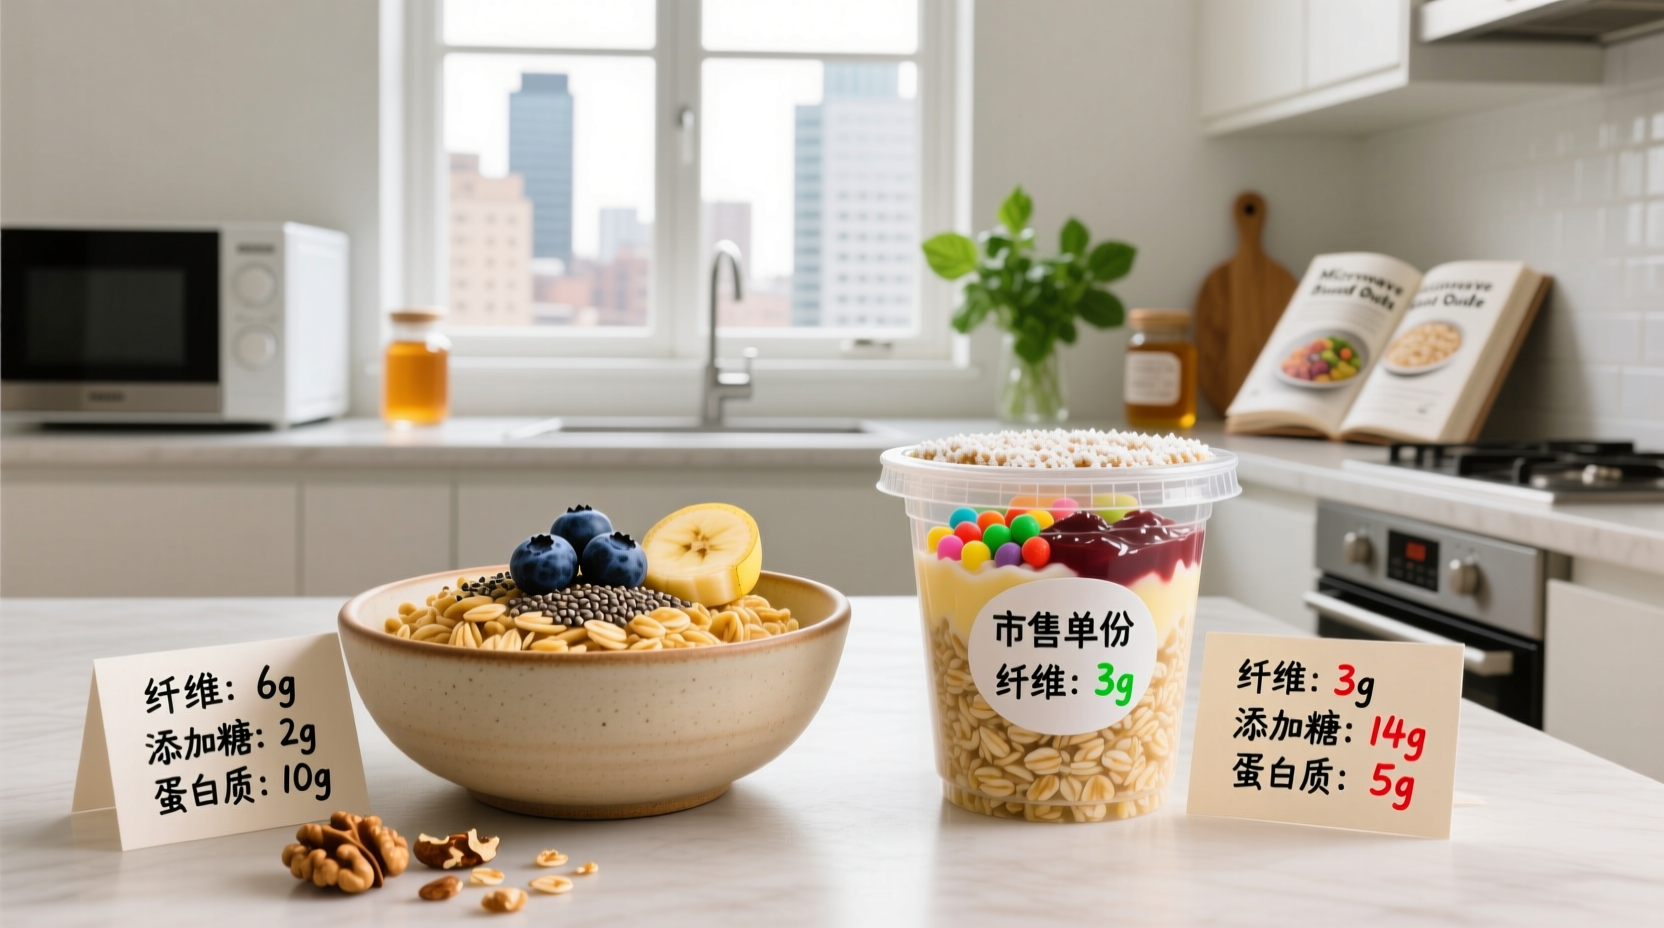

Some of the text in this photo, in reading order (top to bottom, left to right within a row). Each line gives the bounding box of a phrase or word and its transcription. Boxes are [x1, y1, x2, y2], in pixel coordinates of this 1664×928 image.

[993, 610, 1135, 649] 市售单份
[145, 664, 296, 714] 纤维： 6g
[996, 662, 1135, 706] 纤维： 3g
[1236, 659, 1375, 708] 纤维： 3g
[145, 717, 316, 765] 添加糖： 2g
[1232, 707, 1427, 762] 添加糖： 14g
[154, 762, 332, 816] 蛋白质： 10g
[1232, 753, 1416, 811] 蛋白质： 5g
